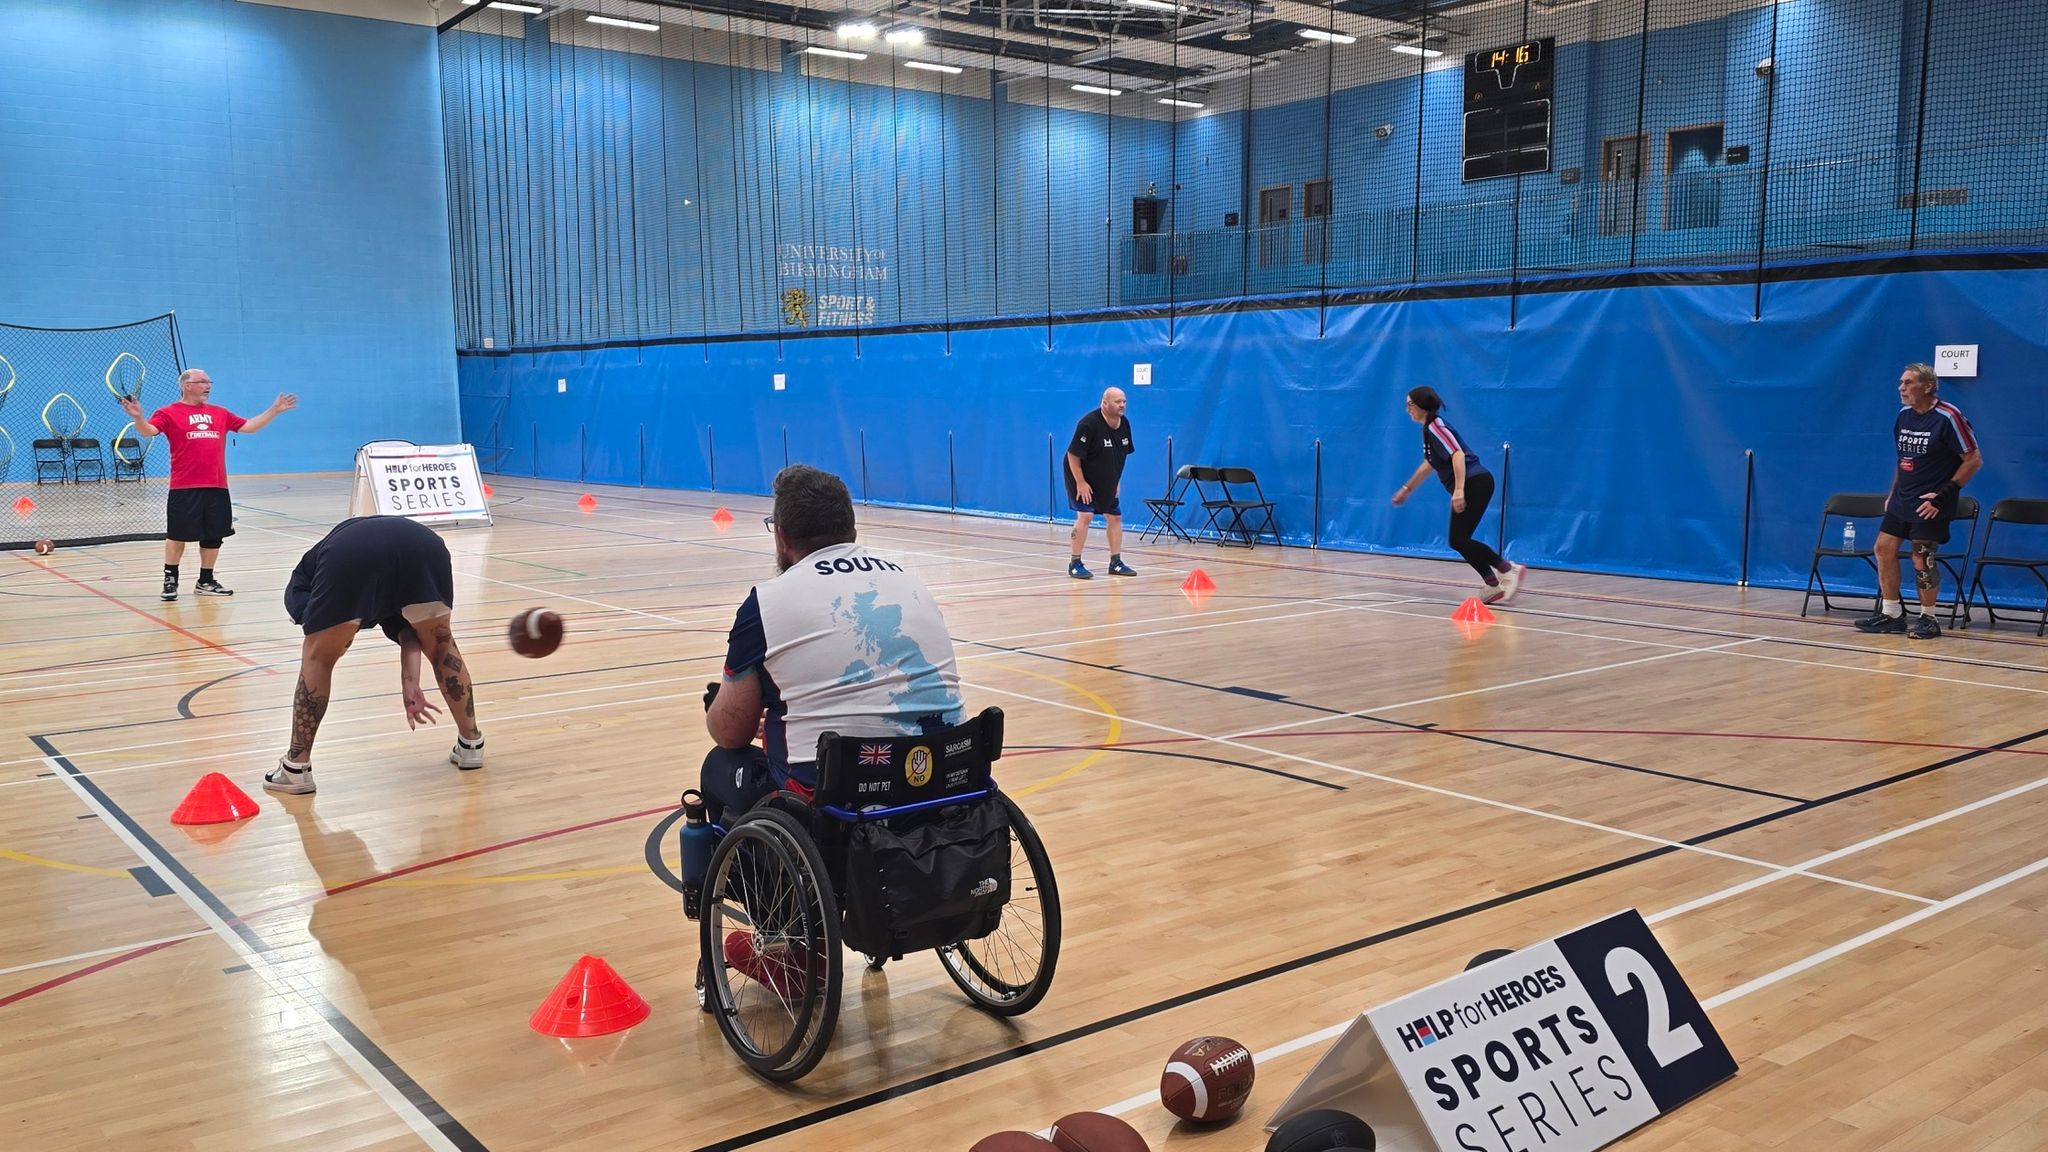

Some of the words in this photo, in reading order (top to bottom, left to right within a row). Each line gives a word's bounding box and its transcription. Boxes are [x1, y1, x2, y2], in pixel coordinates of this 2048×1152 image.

[818, 294, 864, 311] SPORT
[818, 311, 874, 326] FITNESS
[1941, 350, 1970, 358] COURT
[1953, 362, 1959, 370] 5
[188, 413, 213, 425] ARMY
[1898, 434, 1929, 445] SPORTS
[1898, 443, 1928, 454] SERIES
[408, 463, 421, 473] for
[422, 462, 457, 472] HEROES
[388, 475, 461, 492] SPORTS
[391, 491, 466, 511] SERIES
[814, 556, 904, 576] SOUTH
[945, 737, 972, 754] SARCASM
[858, 782, 867, 793] DO
[868, 781, 880, 793] NOT
[881, 780, 891, 792] PET
[913, 775, 926, 784] NO
[1396, 1008, 1454, 1053] HELP
[1453, 1002, 1487, 1029] for
[1480, 965, 1566, 1018] HEROES
[1604, 946, 1704, 1069] 2
[1424, 1005, 1599, 1111] SPORTS
[1455, 1055, 1633, 1152] SERIES
